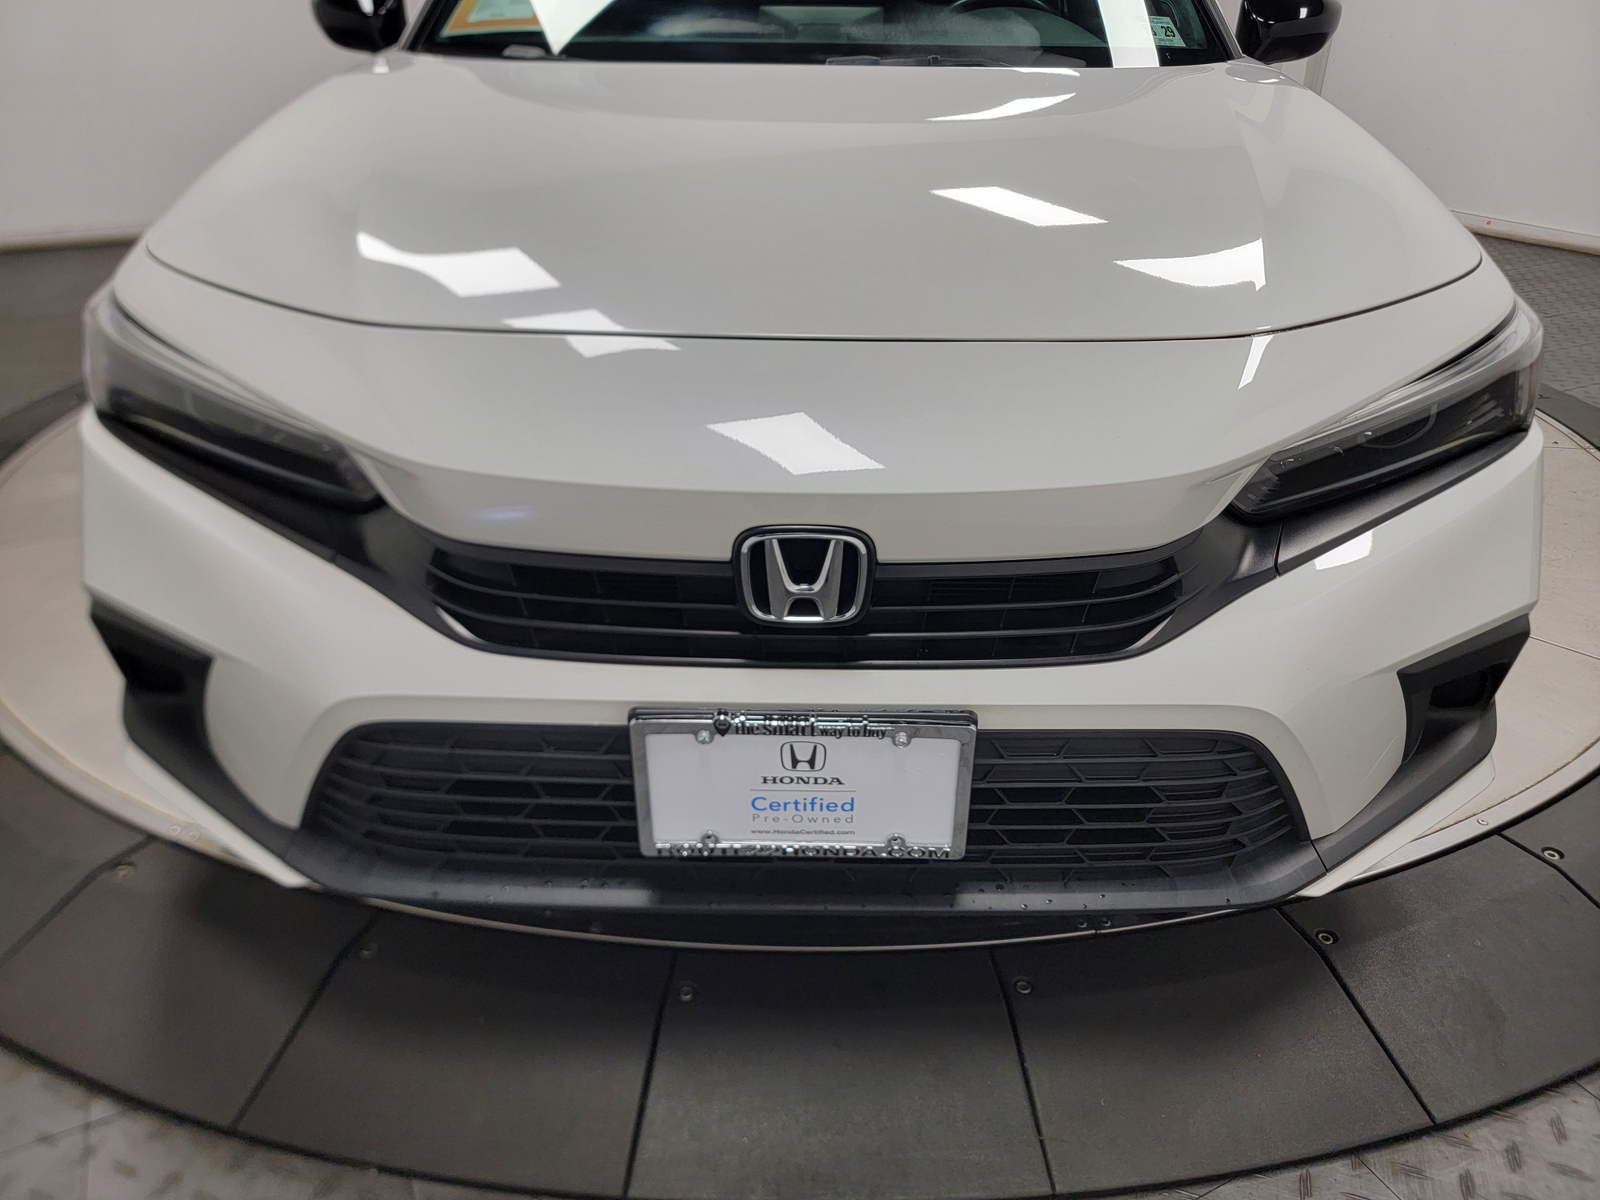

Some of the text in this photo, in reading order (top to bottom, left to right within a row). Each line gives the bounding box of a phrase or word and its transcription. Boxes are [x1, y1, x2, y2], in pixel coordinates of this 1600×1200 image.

[1161, 26, 1176, 37] 29
[735, 718, 888, 740] the smart way to buy
[760, 775, 846, 785] HONDA
[750, 796, 855, 812] Certified
[752, 813, 854, 824] Pre-Owned
